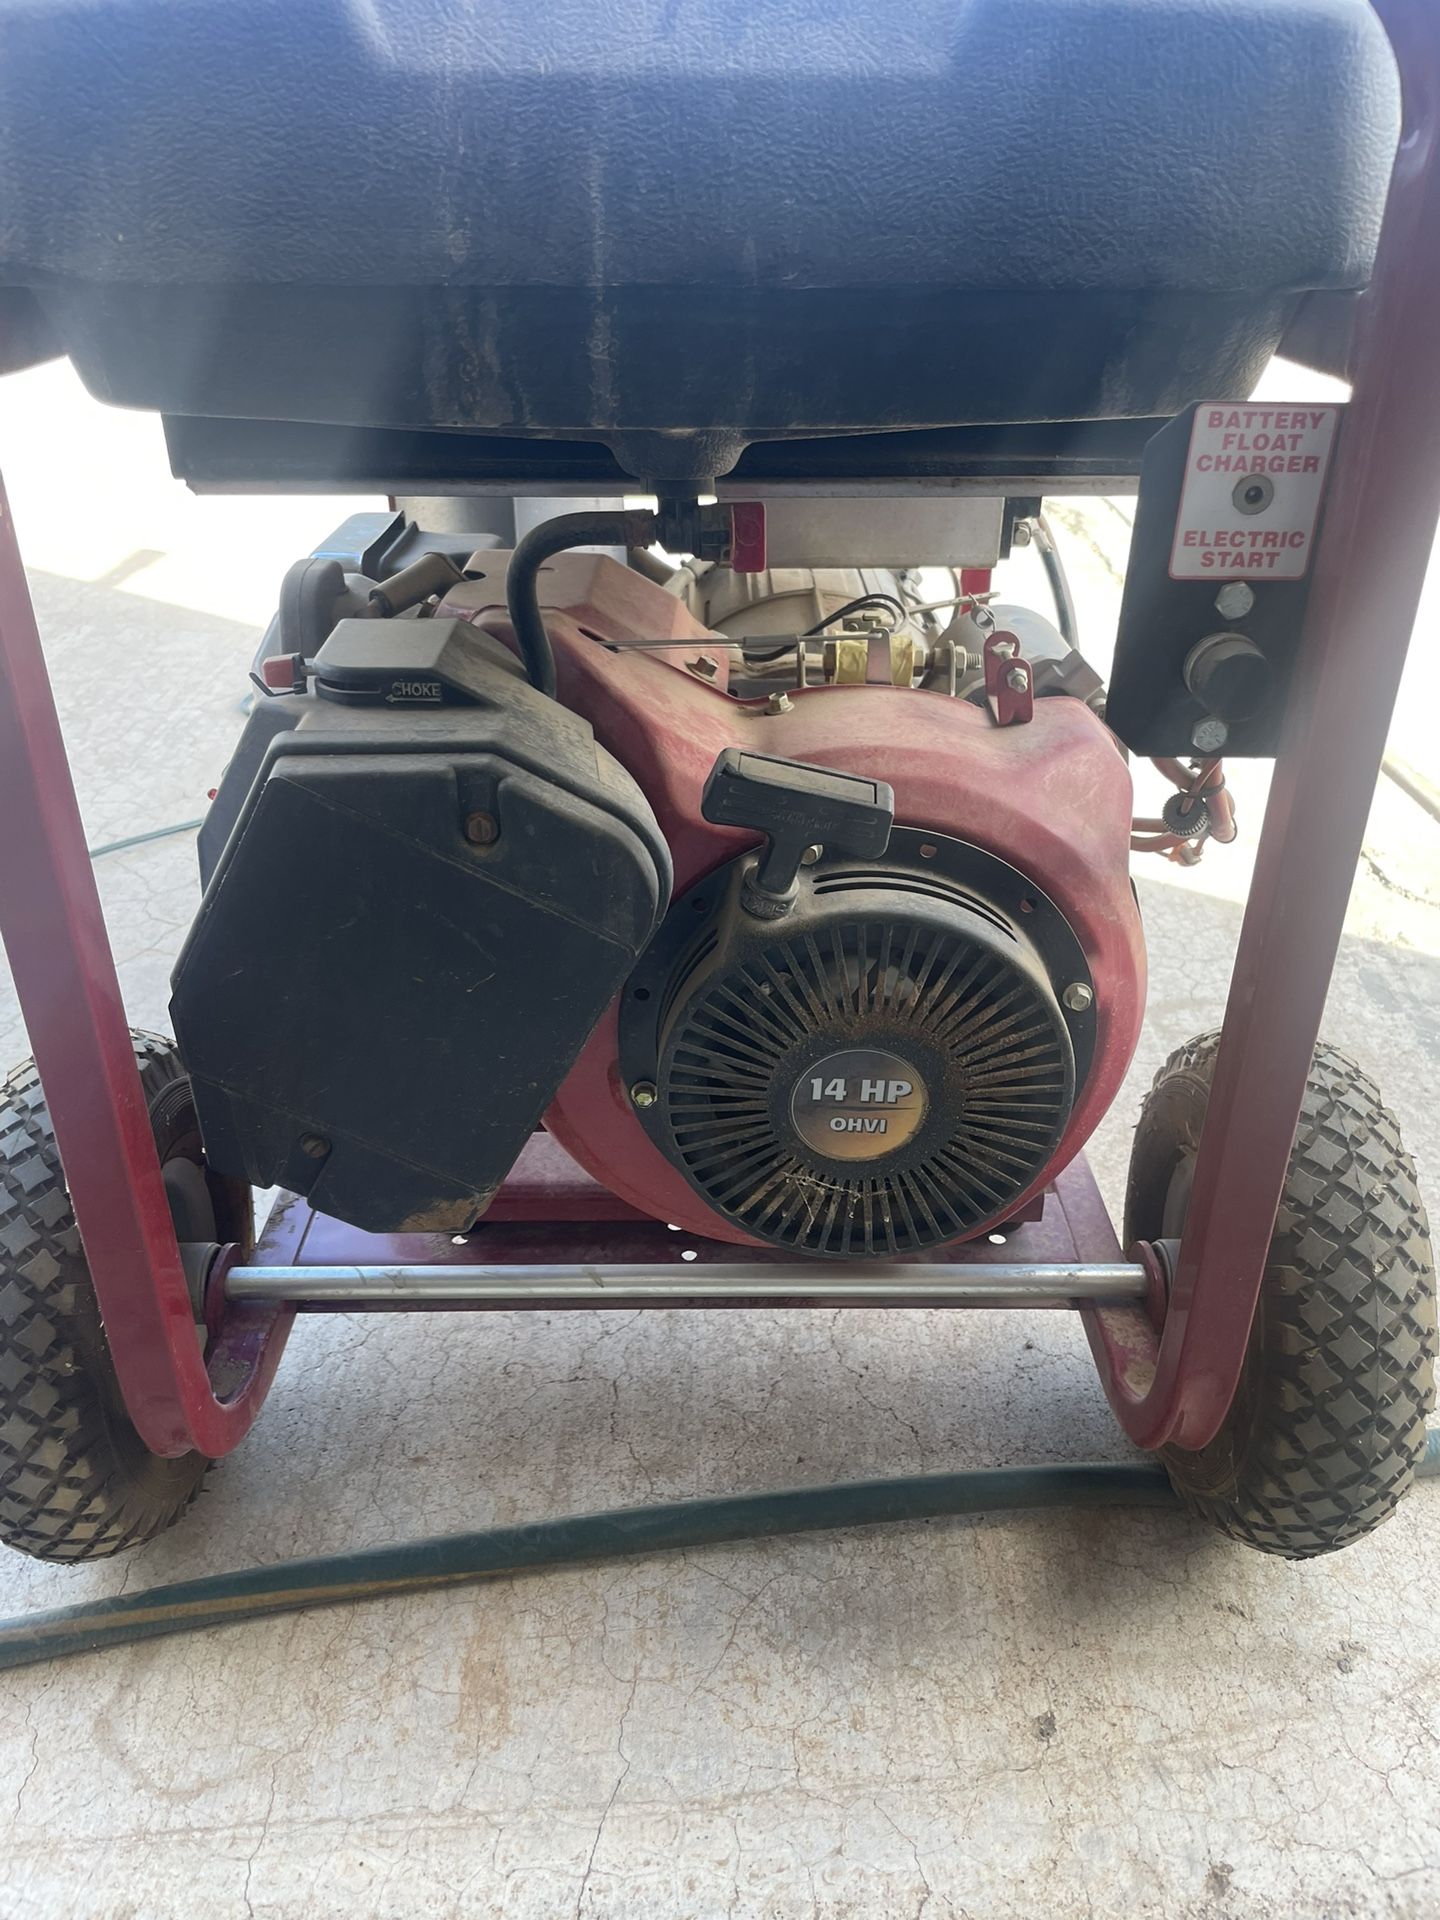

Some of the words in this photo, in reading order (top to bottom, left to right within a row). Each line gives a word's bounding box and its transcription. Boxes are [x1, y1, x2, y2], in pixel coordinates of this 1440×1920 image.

[1208, 411, 1326, 430] BATTERY
[1222, 433, 1304, 451] FLOAT
[1196, 454, 1321, 473] CHARGER
[1183, 530, 1305, 548] ELECTRIC
[1200, 551, 1281, 568] START
[391, 682, 442, 697] CHOKE
[811, 1077, 847, 1103] 14
[860, 1079, 913, 1104] HP
[829, 1117, 887, 1133] OHVI
